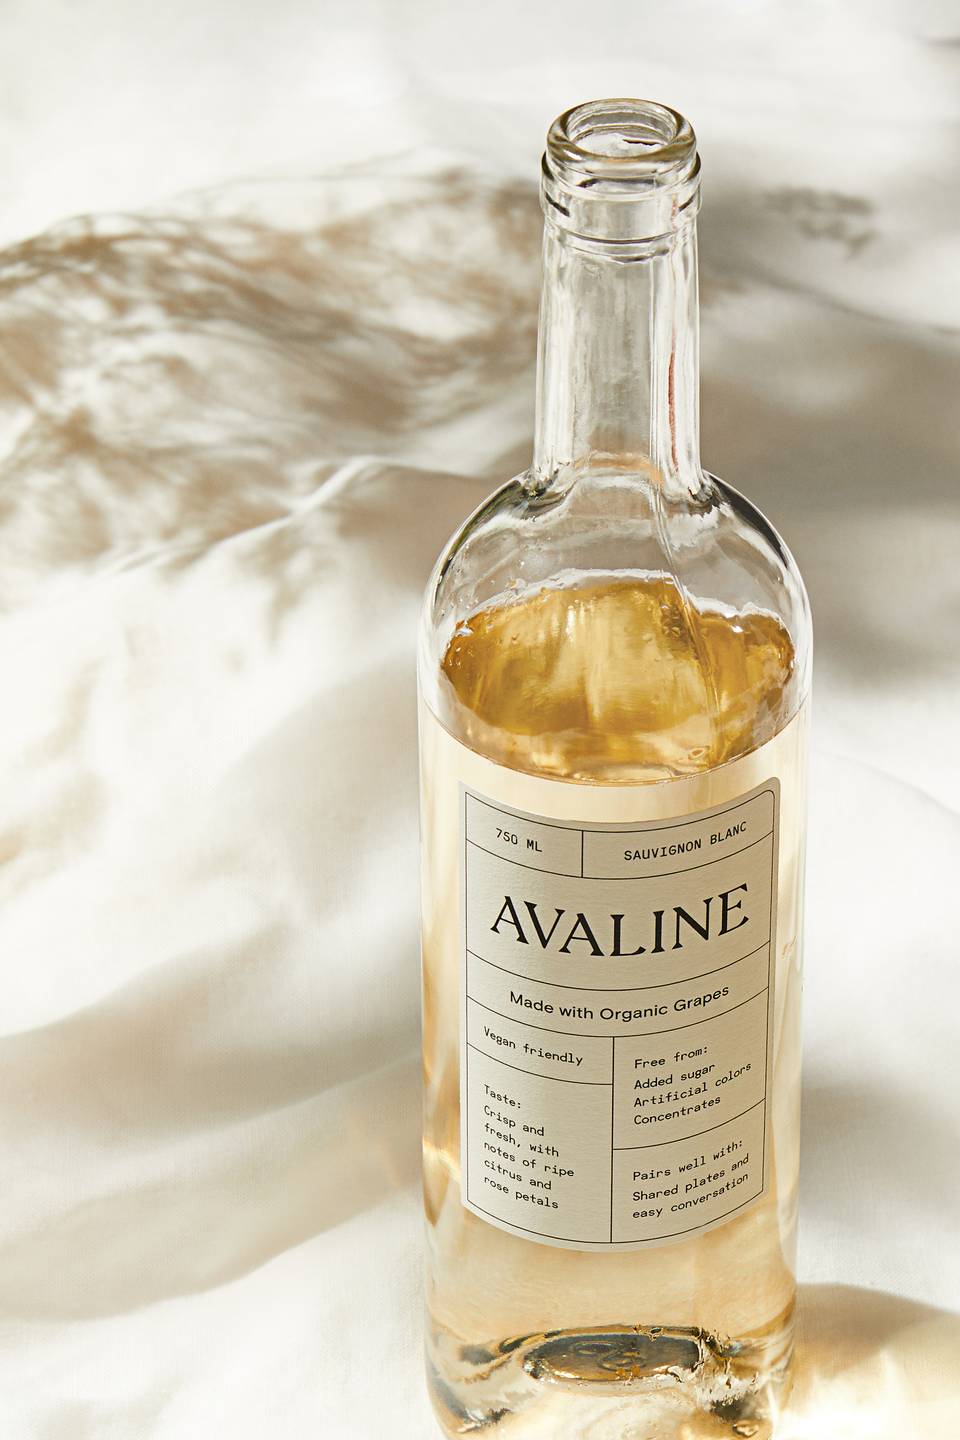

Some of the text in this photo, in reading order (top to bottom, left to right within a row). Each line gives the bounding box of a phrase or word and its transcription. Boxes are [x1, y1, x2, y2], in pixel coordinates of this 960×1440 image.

[495, 827, 543, 852] 750 ML
[623, 821, 747, 861] SAUVIGNON BLANC
[490, 883, 749, 957] AVALINE
[509, 986, 729, 1022] Made with Organic Grapes
[483, 1026, 583, 1066] Vegan friendly
[634, 1046, 708, 1069] Free from:
[634, 1064, 715, 1090] Added sugar
[634, 1064, 752, 1108] Artificial colors
[484, 1084, 521, 1109] Taste:
[634, 1096, 721, 1125] Concentrates
[484, 1105, 545, 1137] Crisp and
[484, 1122, 560, 1157] fresh, with
[484, 1143, 575, 1179] notes of ripe
[484, 1159, 552, 1191] citrus and
[632, 1153, 750, 1201] Shared plates and
[633, 1139, 743, 1181] Pairs well with:
[484, 1177, 559, 1209] rose petals
[632, 1174, 749, 1220] easy conversation
